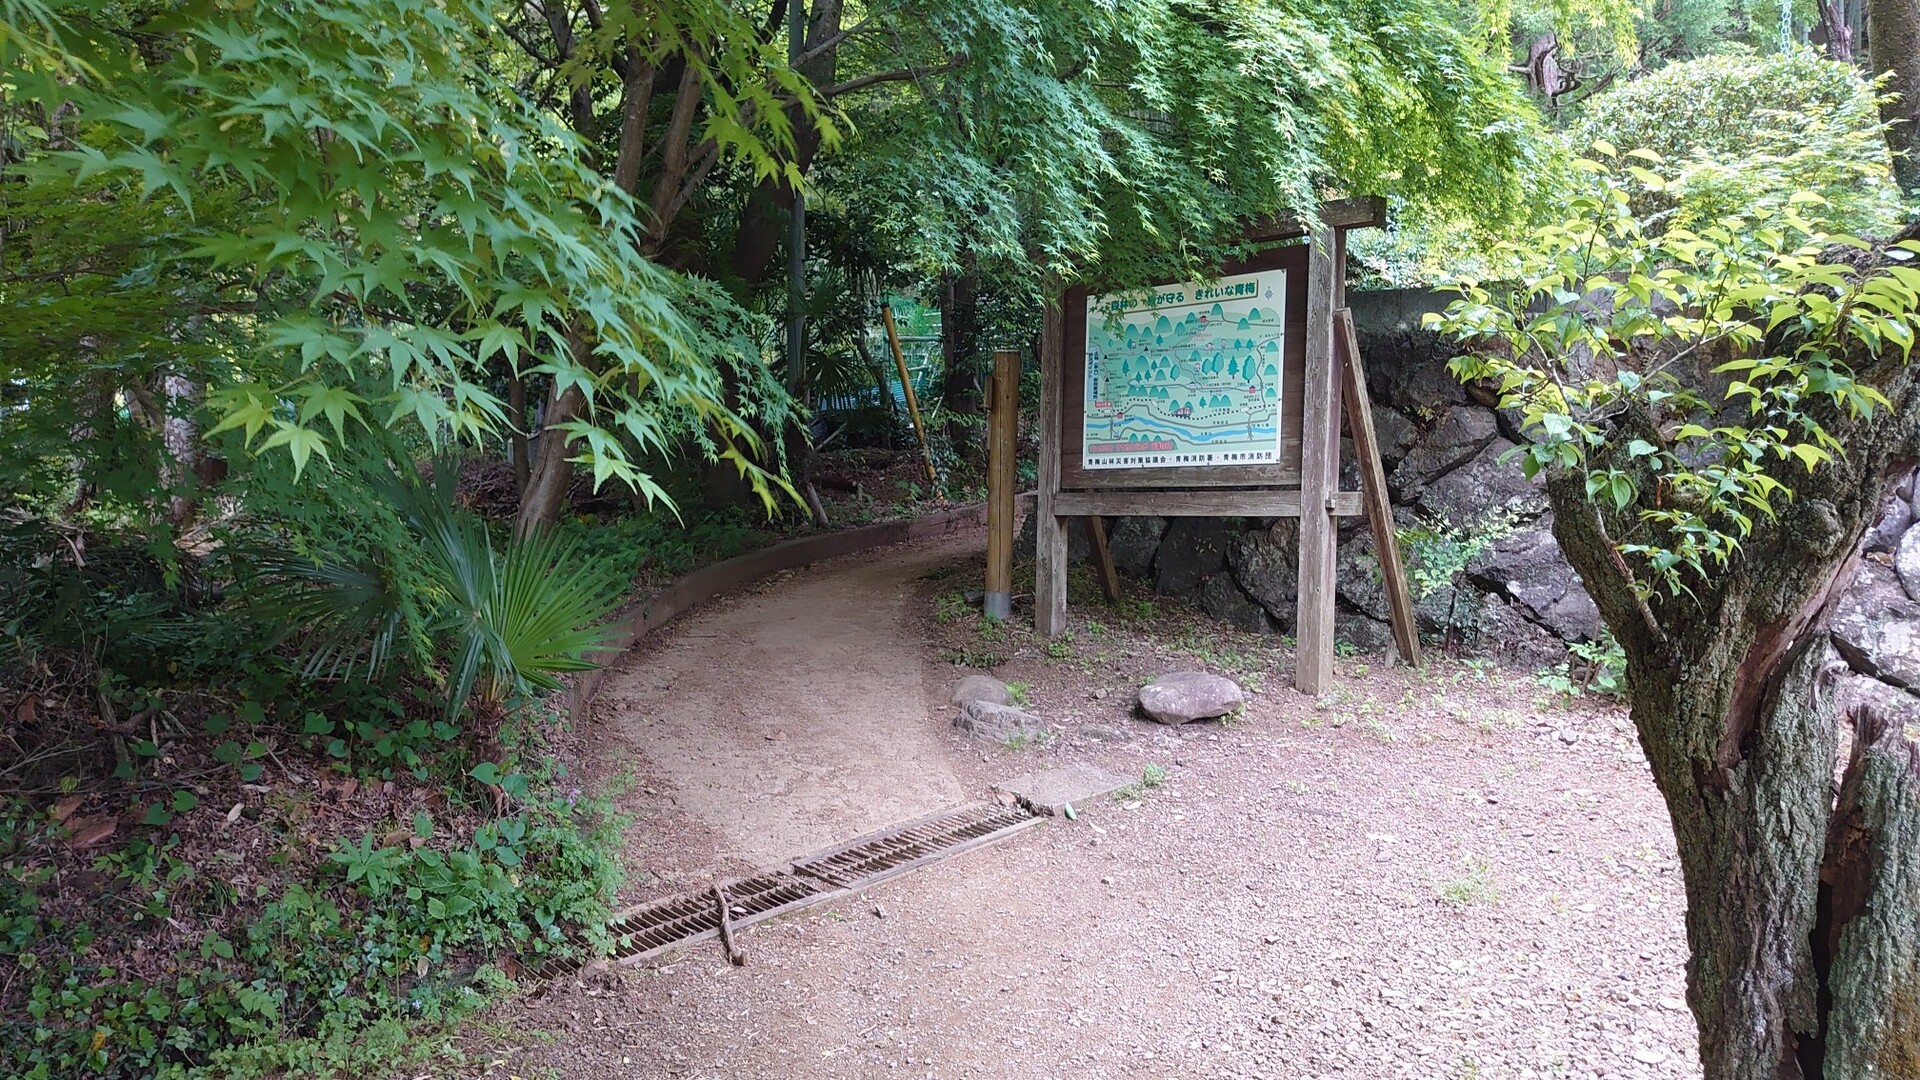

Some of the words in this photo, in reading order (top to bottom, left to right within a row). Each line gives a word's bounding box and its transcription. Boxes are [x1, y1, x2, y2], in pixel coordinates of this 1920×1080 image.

[1194, 282, 1256, 299] きれいな青梅
